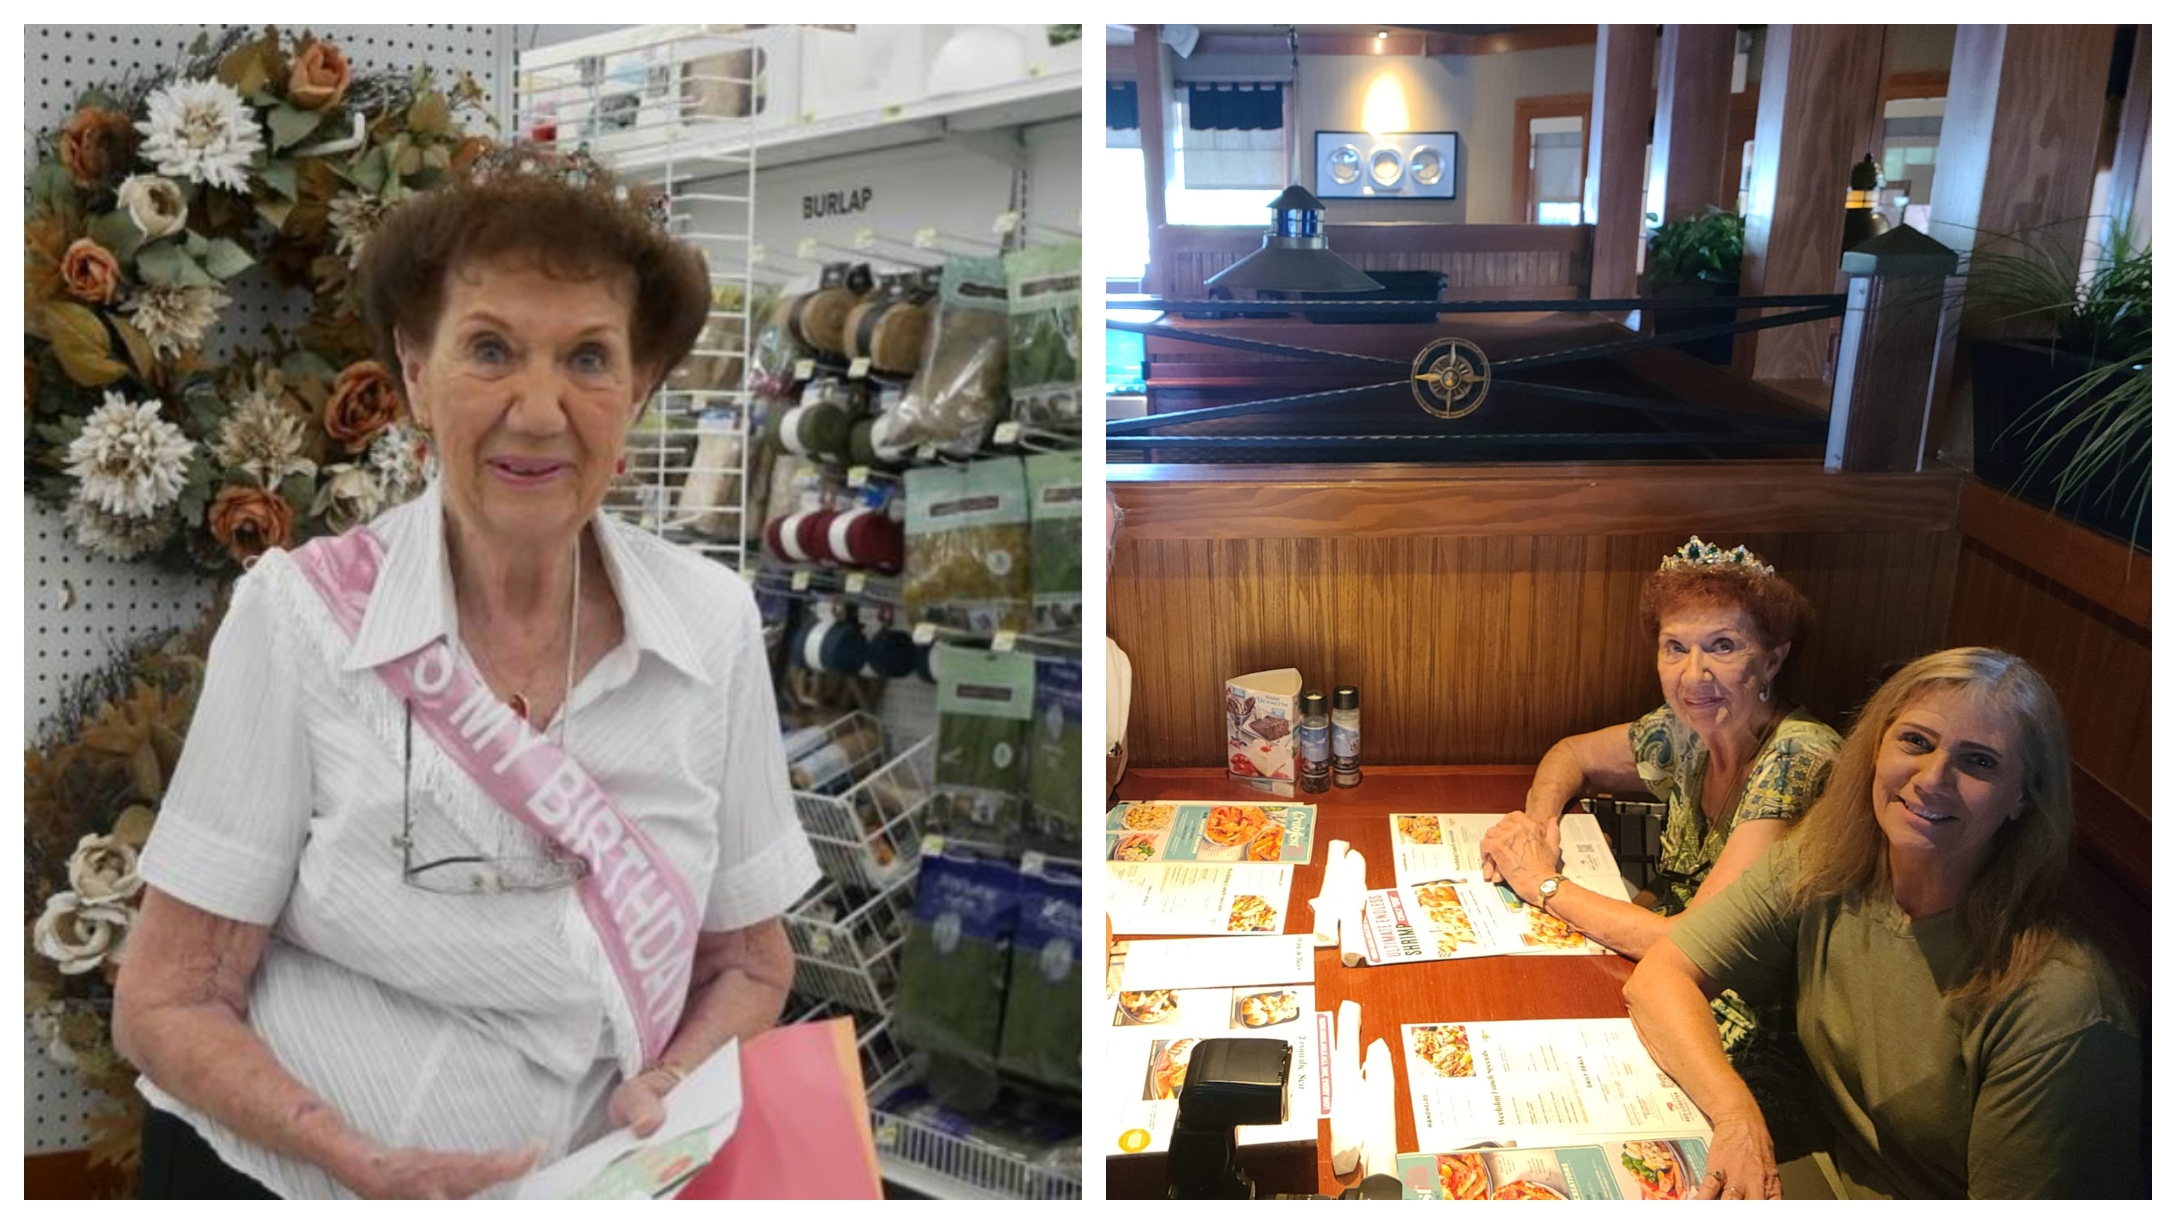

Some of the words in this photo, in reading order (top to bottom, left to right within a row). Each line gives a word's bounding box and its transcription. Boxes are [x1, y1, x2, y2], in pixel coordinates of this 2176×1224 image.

[803, 187, 873, 219] BURLAP
[413, 645, 454, 694] O
[448, 688, 549, 774] MY
[1368, 895, 1391, 923] ENDLESS
[1377, 924, 1402, 957] ULTIMATE
[1395, 923, 1422, 956] SHRIMP
[1298, 1074, 1307, 1090] Sea
[1583, 1073, 1593, 1088] DAILY
